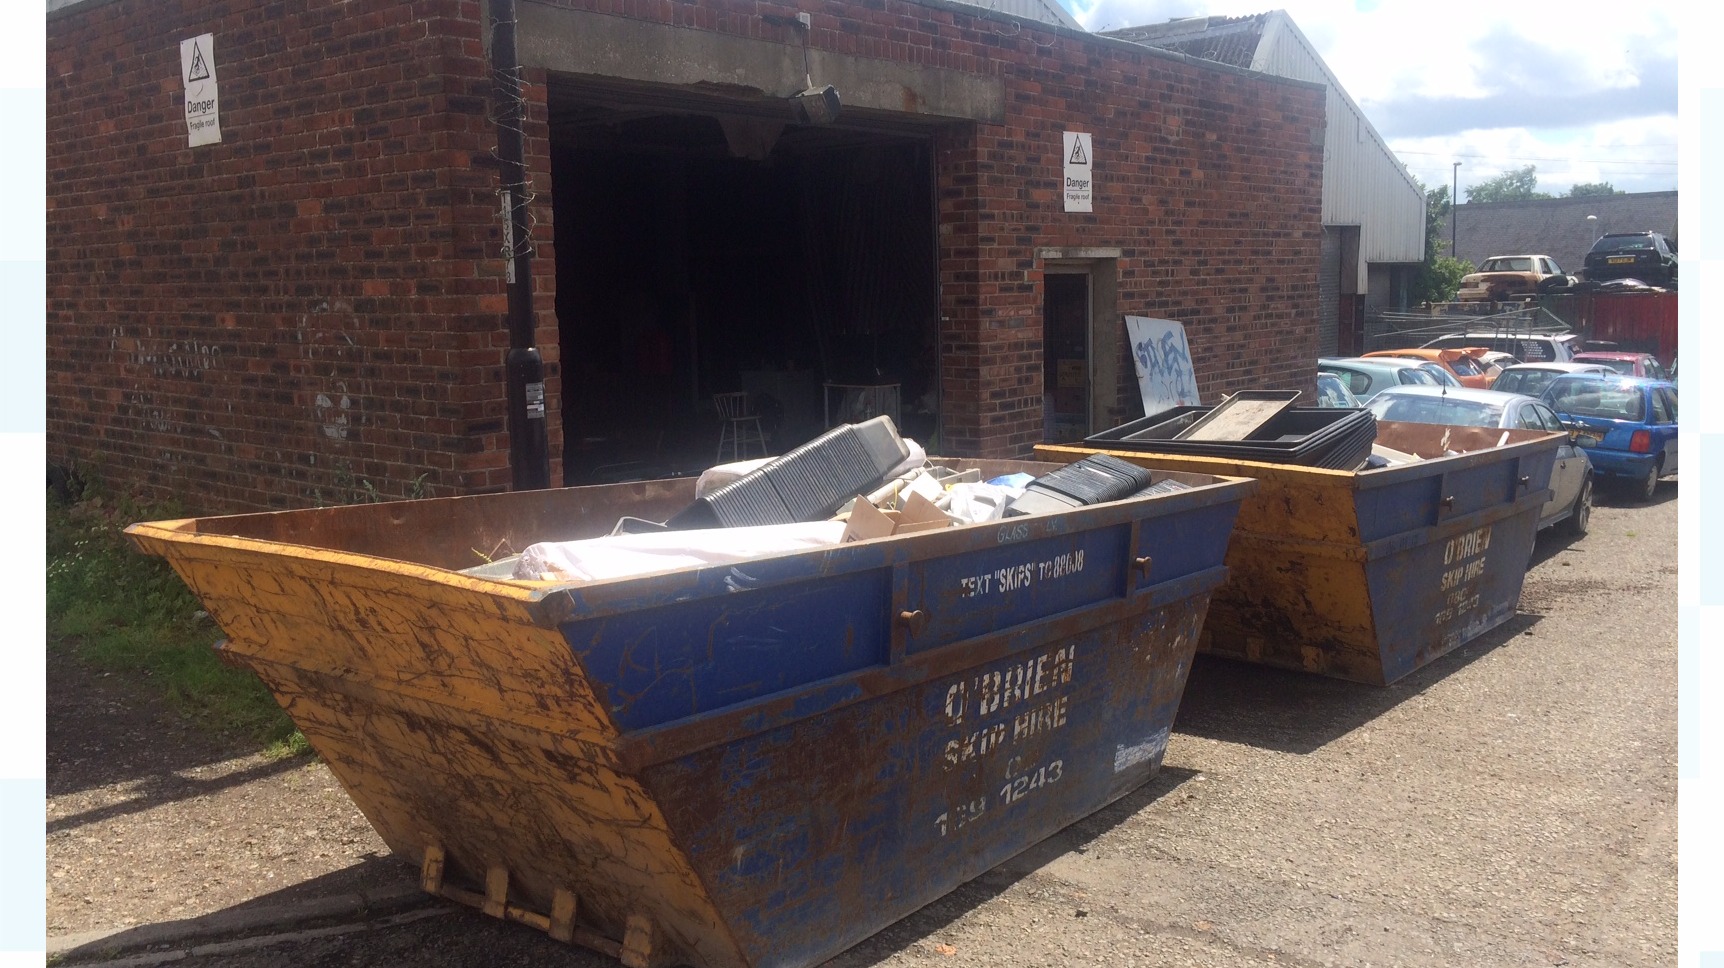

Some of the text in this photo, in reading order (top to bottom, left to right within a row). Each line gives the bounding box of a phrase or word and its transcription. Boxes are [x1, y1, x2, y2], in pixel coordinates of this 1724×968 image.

[188, 99, 215, 113] Danger
[190, 118, 215, 131] Fragile roof
[1066, 177, 1090, 190] Danger
[1066, 192, 1081, 201] Fragile
[997, 523, 1029, 544] GLASS
[1442, 557, 1485, 591] SKIP HIRE
[961, 574, 991, 598] TEXT
[945, 645, 1076, 728] O'BRIEN
[943, 724, 1006, 772] SKIP
[1012, 696, 1069, 744] HIRE
[1000, 759, 1063, 804] 1243
